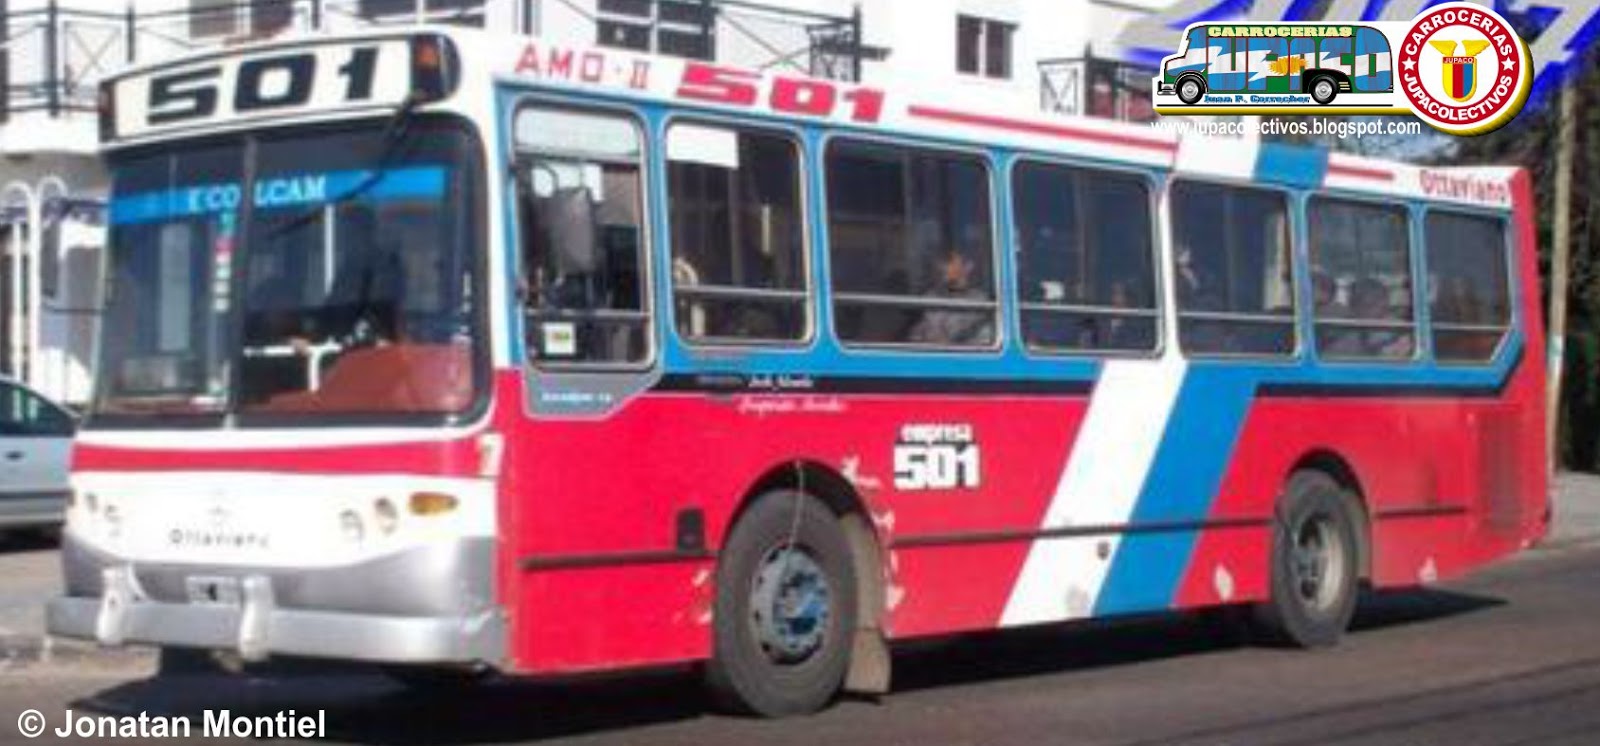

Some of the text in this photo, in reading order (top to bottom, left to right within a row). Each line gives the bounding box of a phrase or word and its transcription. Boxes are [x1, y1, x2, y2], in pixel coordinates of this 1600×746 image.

[147, 46, 380, 125] 501
[677, 61, 884, 123] 501
[894, 443, 980, 489] 501
